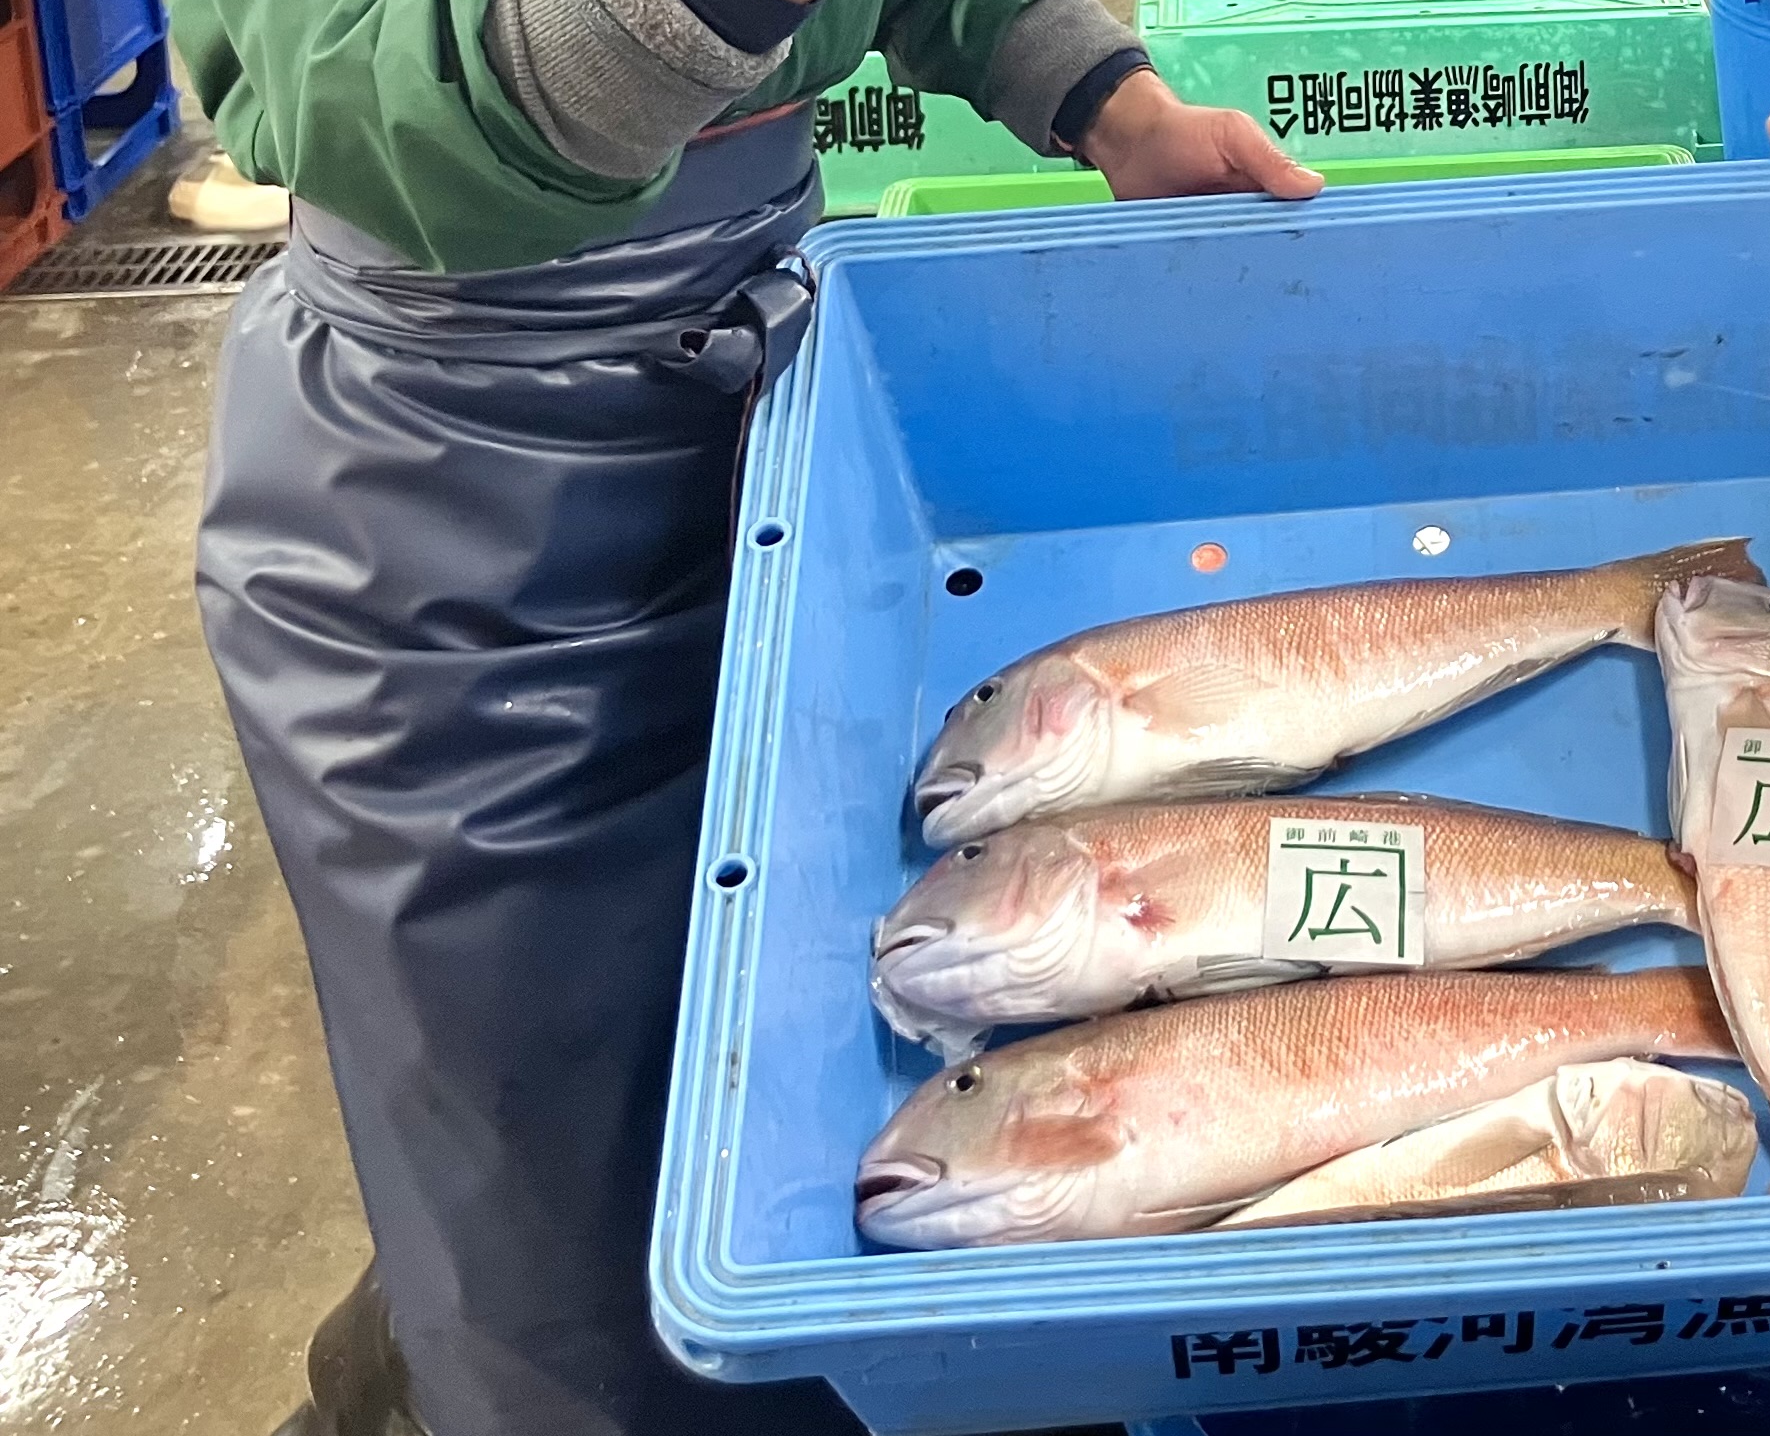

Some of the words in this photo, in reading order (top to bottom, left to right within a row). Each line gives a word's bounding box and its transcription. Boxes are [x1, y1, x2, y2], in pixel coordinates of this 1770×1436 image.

[1266, 60, 1590, 140] 御前崎漁業協同組合
[1287, 857, 1391, 946] 広
